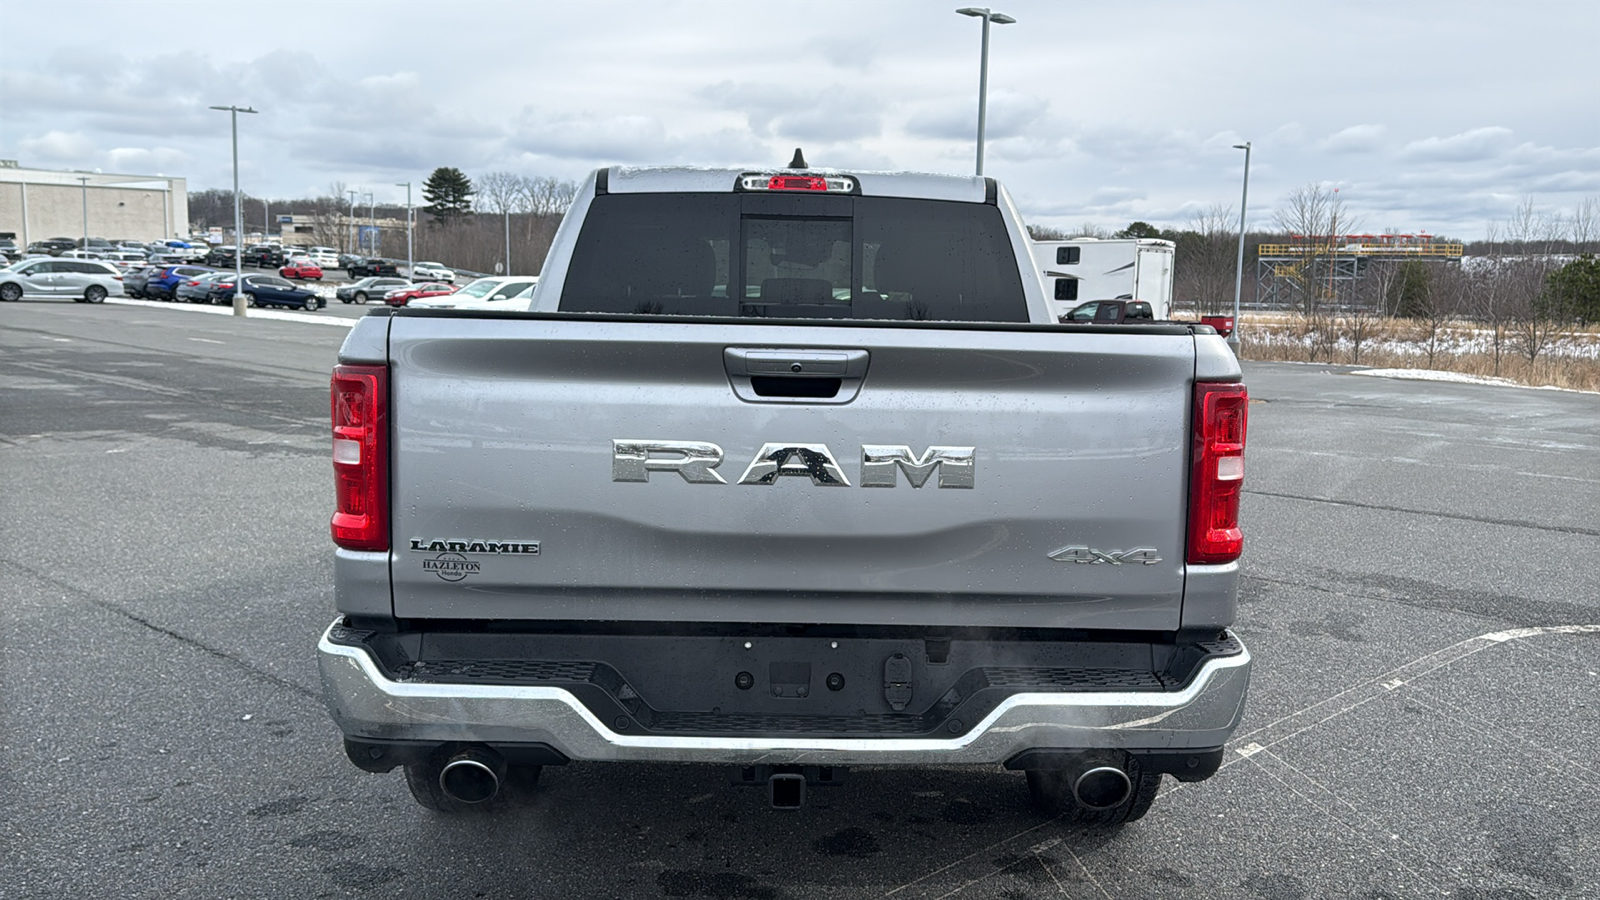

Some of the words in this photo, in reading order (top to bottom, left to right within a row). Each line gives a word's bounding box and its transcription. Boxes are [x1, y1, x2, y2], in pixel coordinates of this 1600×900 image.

[612, 438, 977, 489] RAM
[410, 538, 541, 555] LARAMIE
[423, 561, 481, 571] HAZLETON
